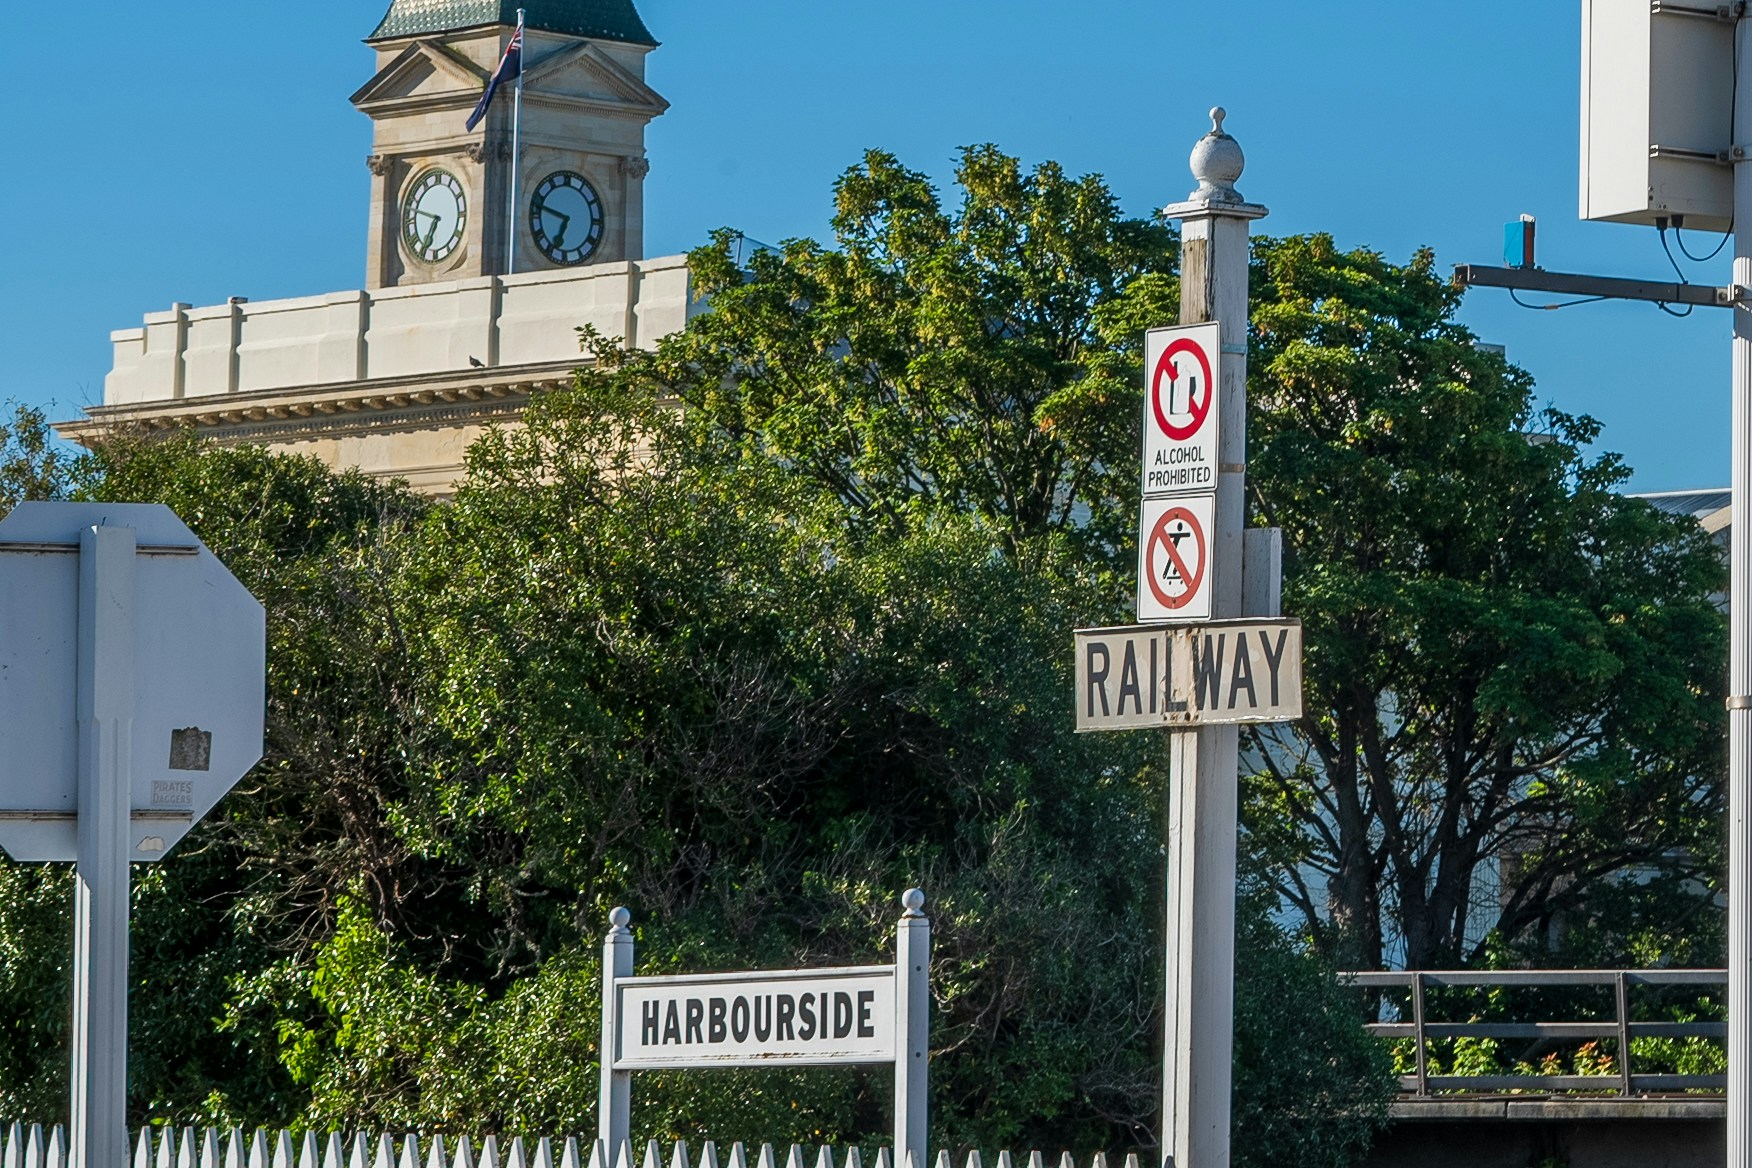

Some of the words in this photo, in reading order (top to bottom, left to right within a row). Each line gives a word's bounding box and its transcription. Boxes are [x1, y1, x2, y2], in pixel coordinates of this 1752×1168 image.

[1154, 445, 1205, 466] ALCOHOL
[1148, 466, 1211, 488] PROHIBITED
[1086, 628, 1289, 718] RAILWAY
[153, 782, 192, 793] PIRATES
[152, 793, 192, 804] DAGGERS
[640, 990, 875, 1046] HARBOURSIDE
